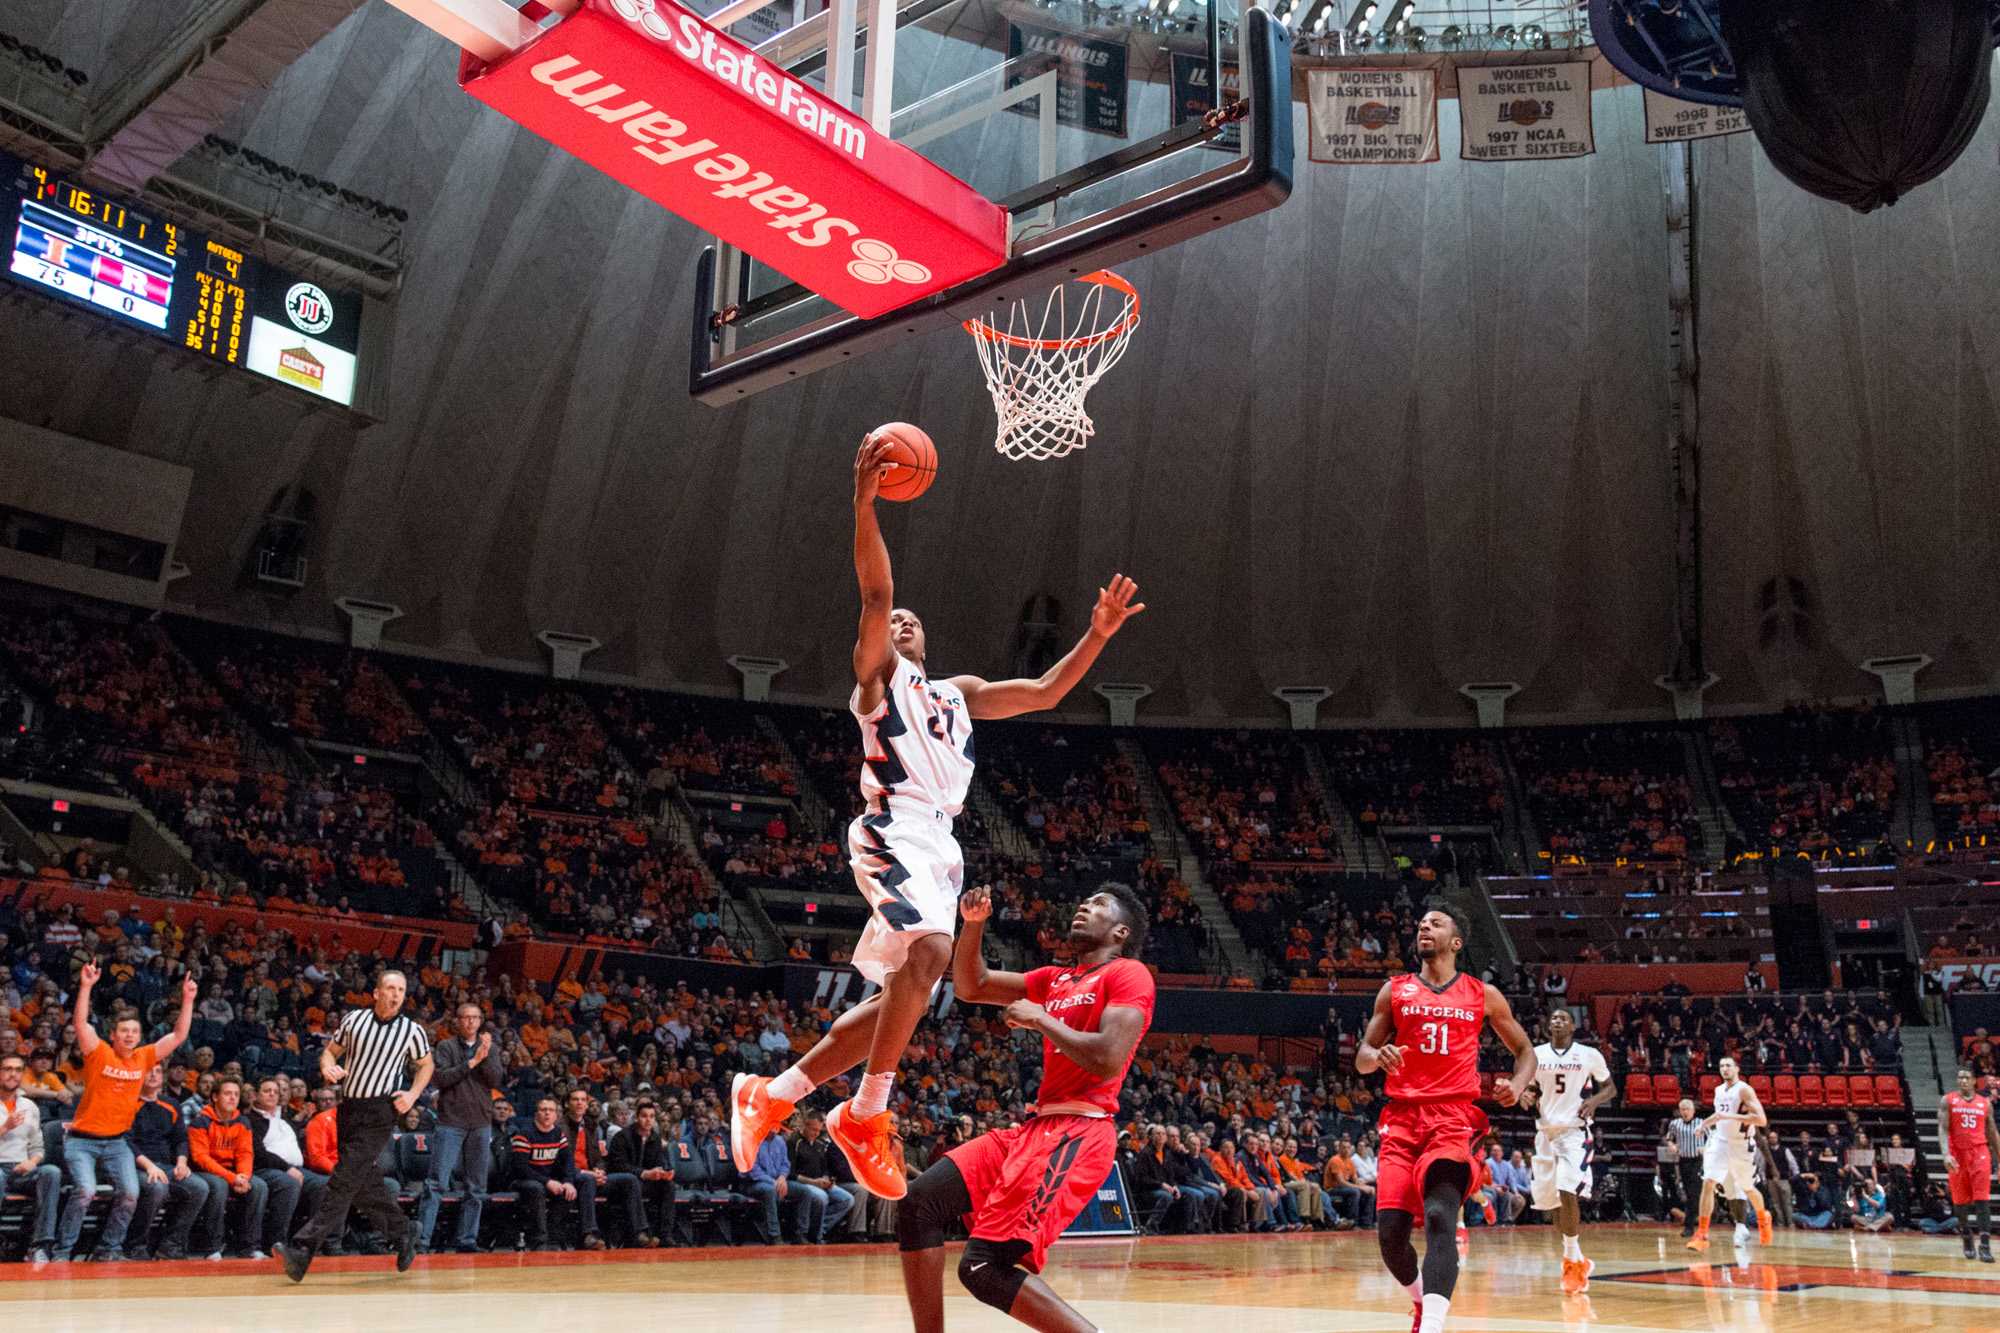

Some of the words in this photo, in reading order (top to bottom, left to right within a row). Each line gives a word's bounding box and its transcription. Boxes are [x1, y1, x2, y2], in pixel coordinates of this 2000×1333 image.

[1340, 72, 1403, 84] WOMEN'S
[1492, 67, 1557, 80] WOMEN'S
[1327, 86, 1417, 97] BASKETBALL
[1478, 80, 1572, 95] BASKETBALL
[1488, 130, 1519, 143] 1997
[1526, 128, 1566, 141] NCAA
[1655, 121, 1707, 138] SWEET
[1327, 133, 1357, 146] 1997
[1364, 133, 1388, 146] BIG
[1396, 133, 1423, 146] TEN
[1333, 146, 1417, 159] CHAMPIONS
[68, 188, 126, 229] 16:11
[74, 226, 125, 258] 3PT%
[37, 262, 67, 287] 75
[226, 261, 238, 280] 4
[121, 296, 135, 313] 0
[1400, 1004, 1475, 1022] RUTGERS
[1420, 1022, 1449, 1056] 31
[1538, 1063, 1583, 1072] ILLINOIS
[1555, 1073, 1566, 1095] 5
[1960, 1113, 1977, 1129] 35
